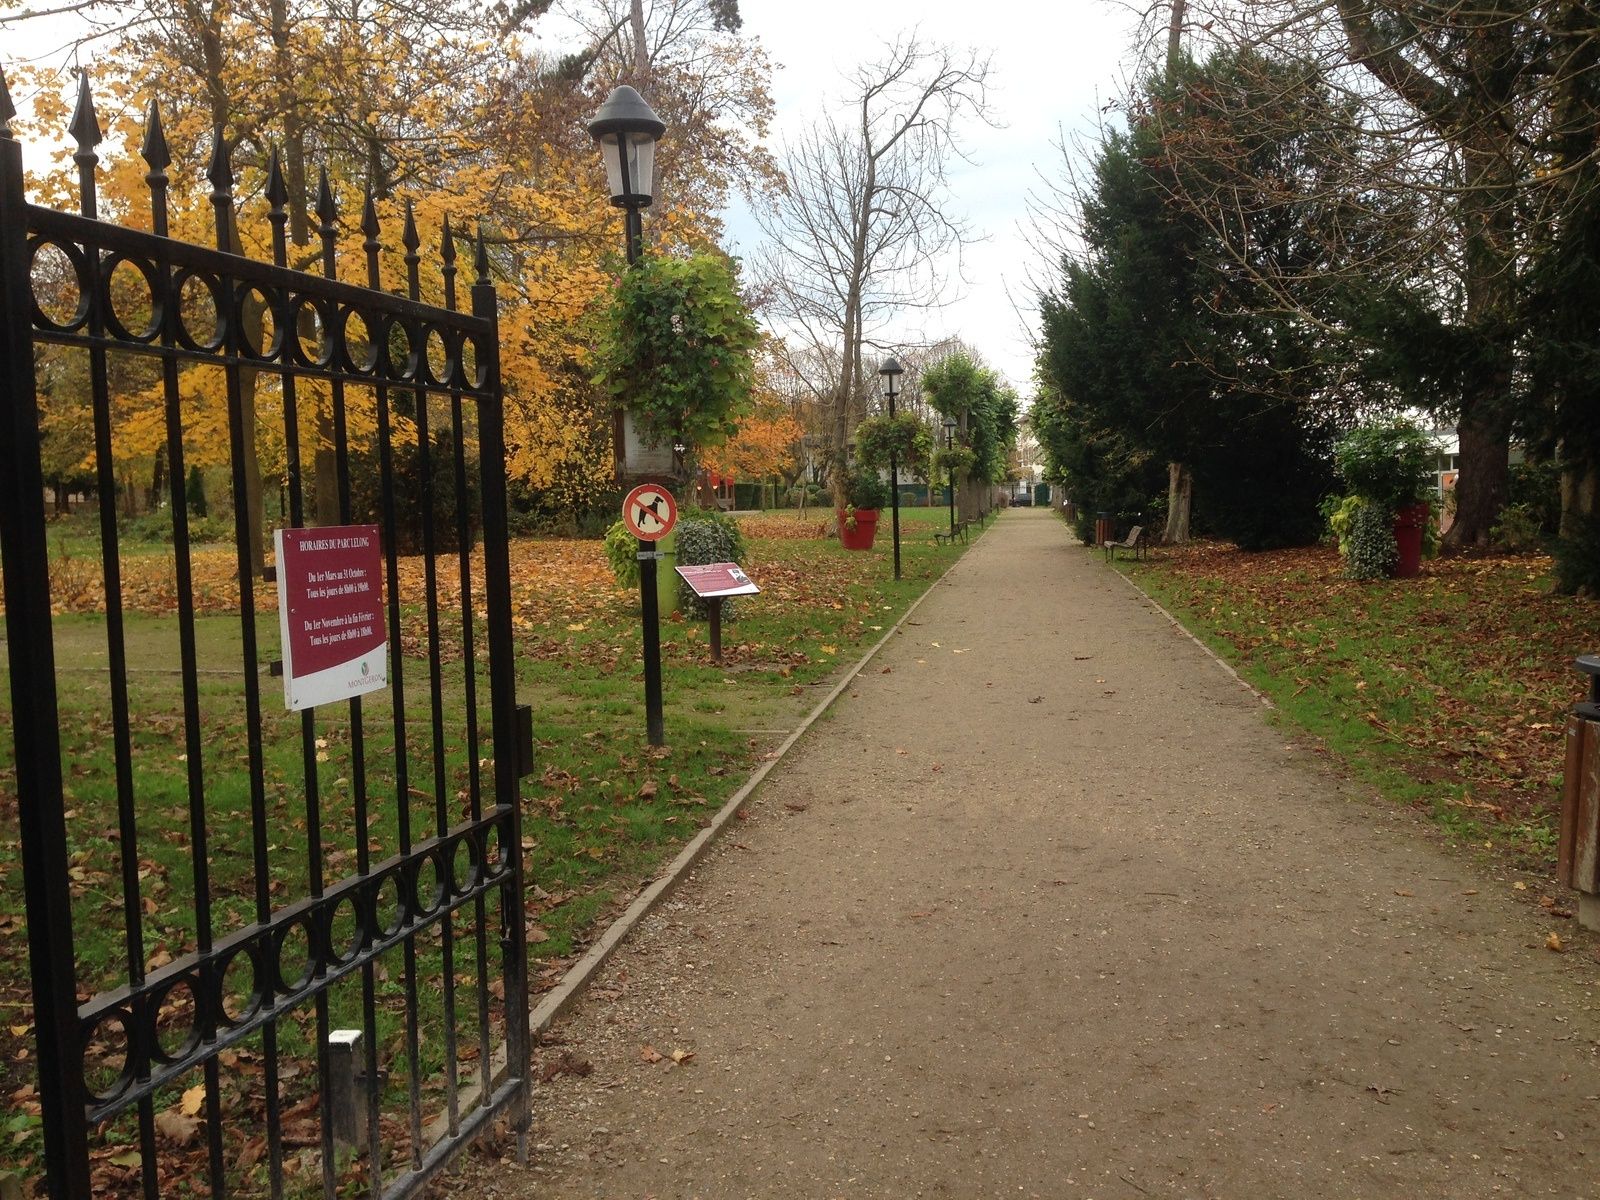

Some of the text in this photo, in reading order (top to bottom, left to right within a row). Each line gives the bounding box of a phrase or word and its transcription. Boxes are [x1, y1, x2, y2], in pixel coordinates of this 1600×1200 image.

[300, 537, 369, 551] HORAIRES DU PARC LELONG
[308, 572, 316, 583] Du
[317, 571, 325, 581] 1er
[325, 570, 336, 581] Mars
[337, 571, 343, 580] au
[348, 568, 364, 578] Octobre
[306, 588, 319, 599] Tous
[326, 586, 338, 599] jours
[338, 584, 344, 595] de
[304, 620, 312, 631] Du
[313, 619, 321, 630] 1er
[321, 616, 344, 628] Novembre
[347, 614, 352, 624] la
[358, 611, 372, 622] Février
[310, 635, 322, 646] Tous
[328, 633, 341, 646] jours
[341, 630, 347, 641] de
[347, 674, 382, 688] MONTGERON
